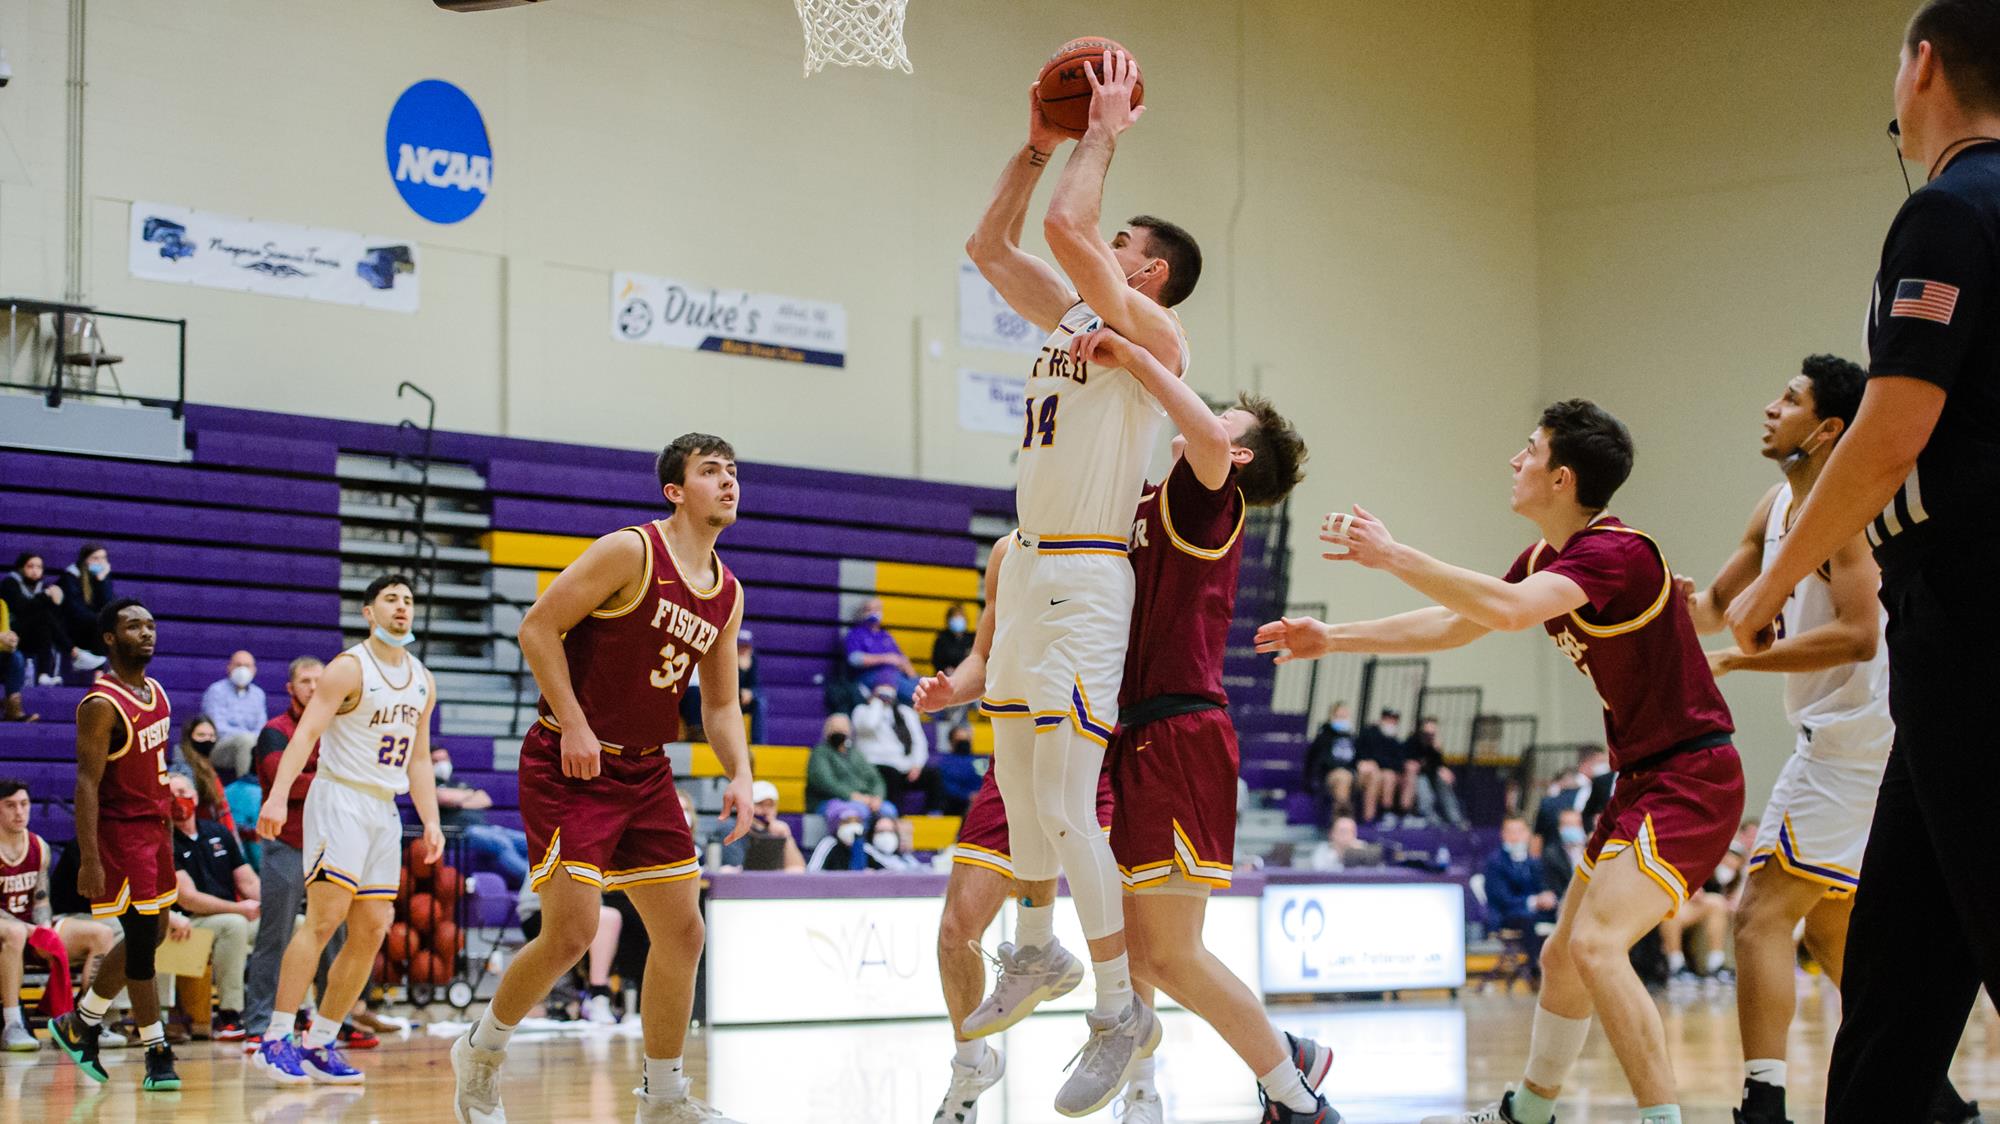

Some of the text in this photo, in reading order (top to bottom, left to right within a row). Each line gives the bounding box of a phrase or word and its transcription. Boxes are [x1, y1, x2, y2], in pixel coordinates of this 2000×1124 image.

[395, 143, 489, 195] NCAA
[664, 285, 761, 334] Duke's
[1022, 393, 1060, 449] 14
[650, 597, 719, 655] FISHER
[649, 642, 691, 694] 32
[378, 734, 410, 767] 23
